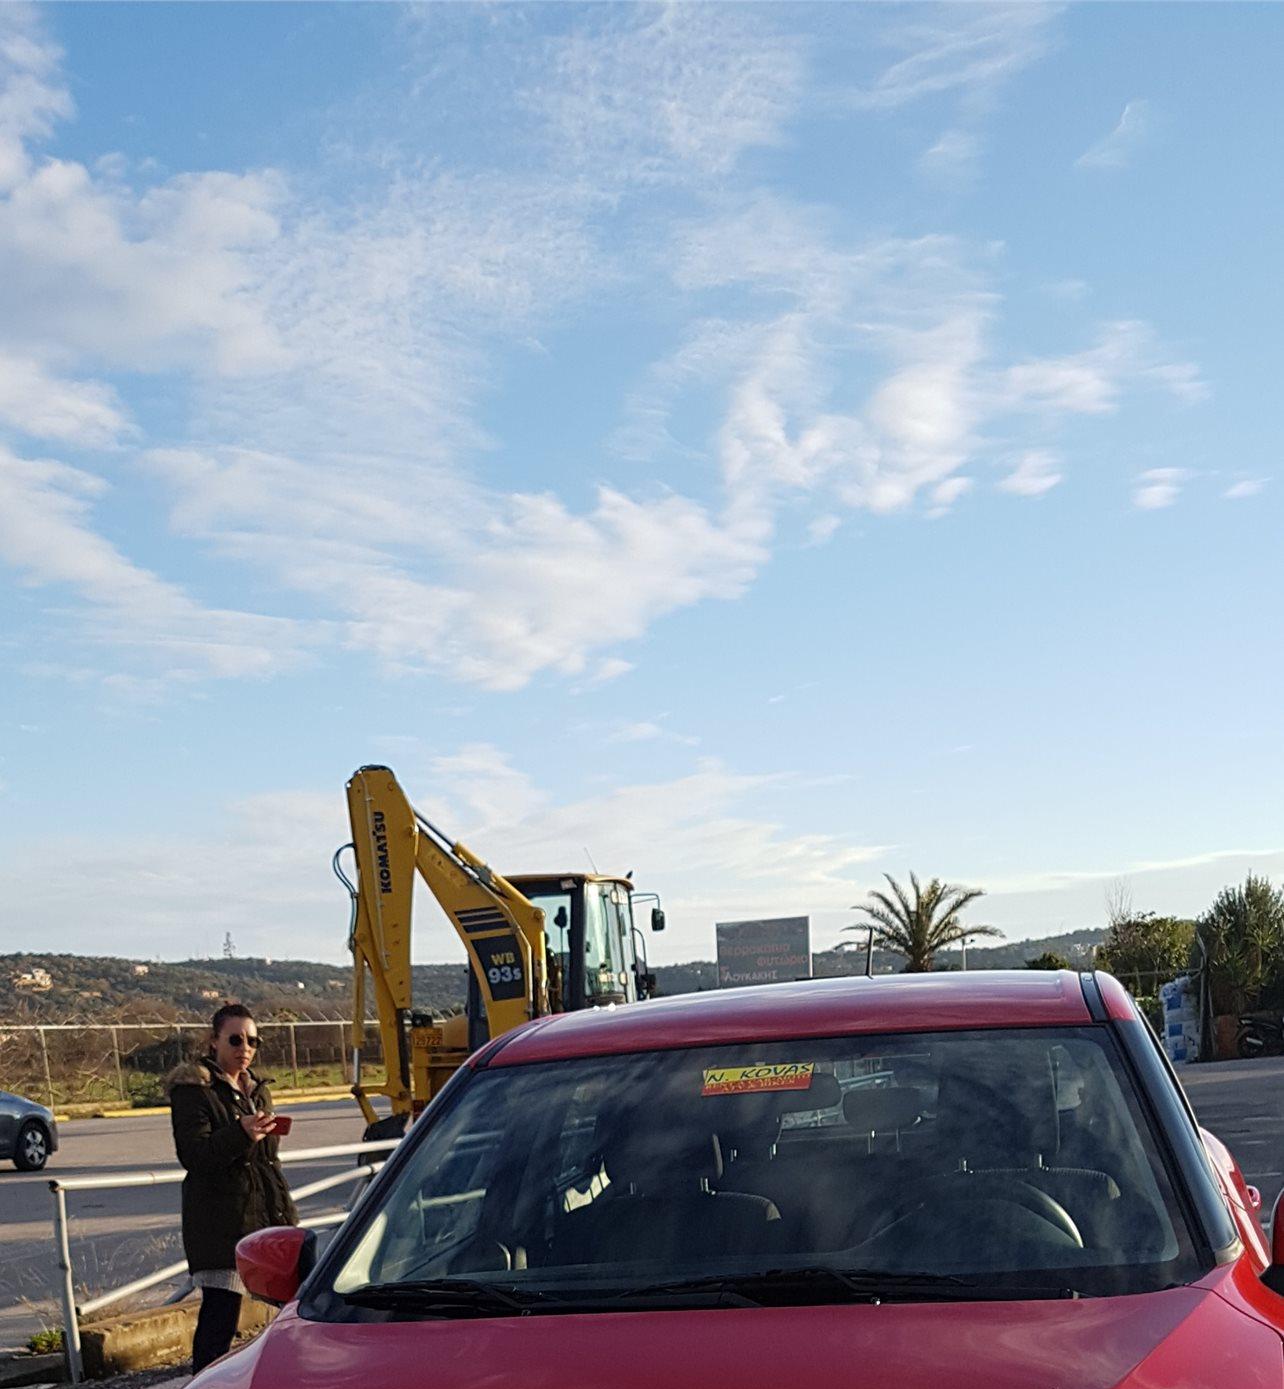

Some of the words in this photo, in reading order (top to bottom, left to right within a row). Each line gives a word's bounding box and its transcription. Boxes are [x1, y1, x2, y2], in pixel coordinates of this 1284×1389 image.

[373, 811, 392, 894] KOMATSU
[490, 951, 515, 966] WB
[740, 1064, 811, 1079] KOVAS
